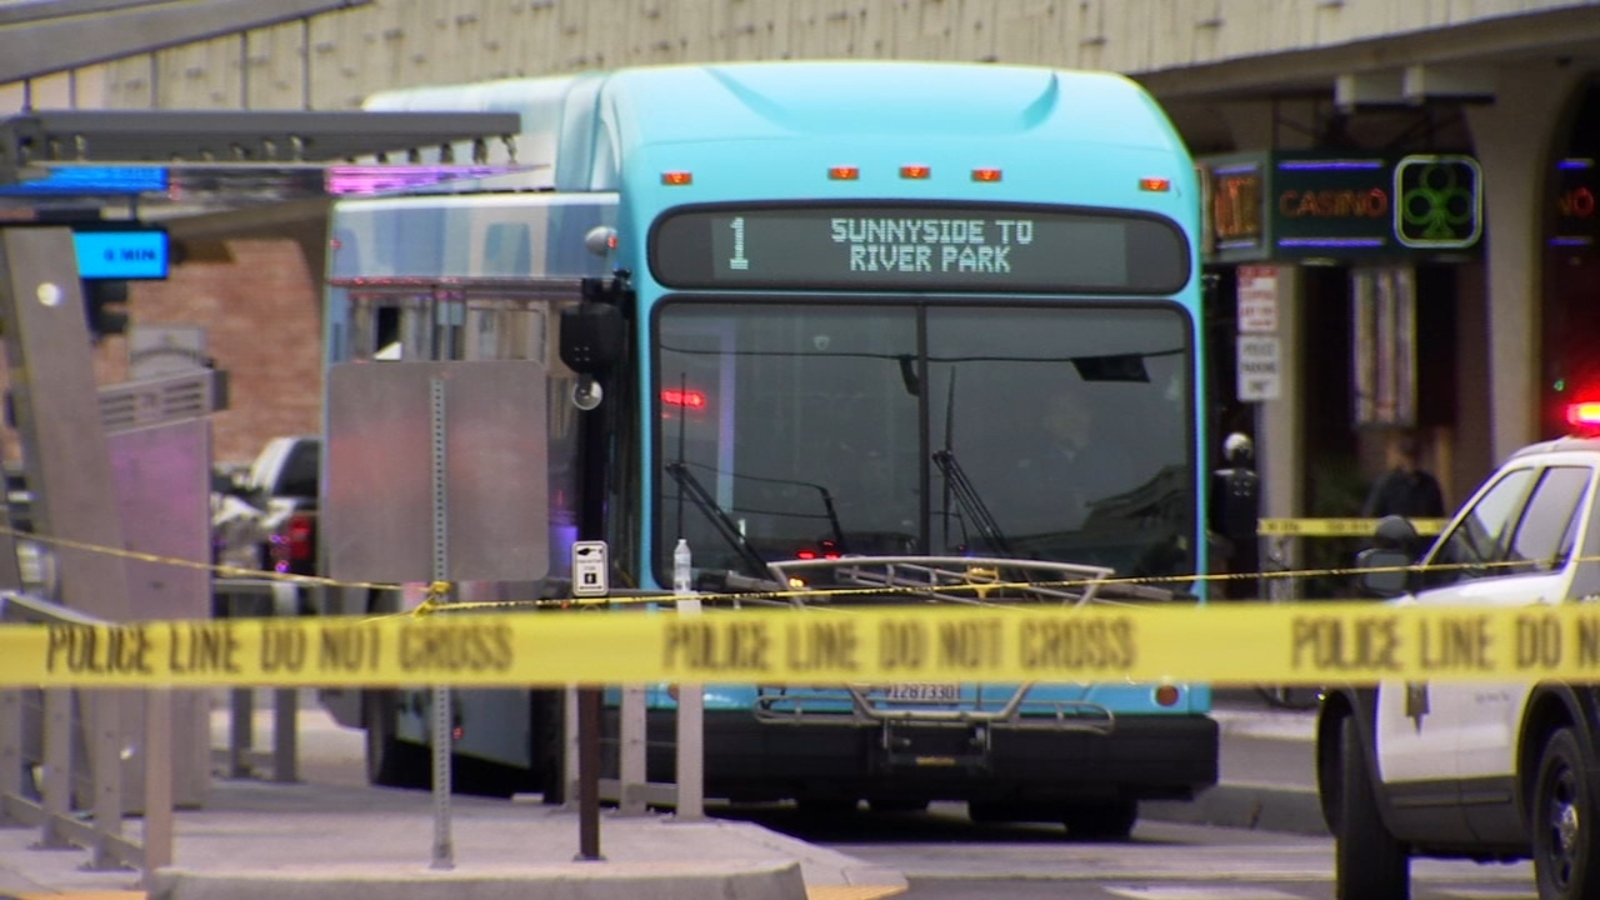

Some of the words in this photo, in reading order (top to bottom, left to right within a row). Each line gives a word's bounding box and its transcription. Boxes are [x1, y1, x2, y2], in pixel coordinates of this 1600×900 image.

[1279, 188, 1388, 218] CASINO
[729, 217, 749, 270] 1
[831, 218, 985, 244] SUNNYSIDE
[995, 219, 1034, 245] TO
[850, 244, 932, 272] RIVER
[941, 244, 1011, 273] PARK
[46, 624, 153, 674] POLICE
[168, 622, 240, 674] LINE
[260, 622, 306, 674] DO
[318, 622, 381, 673] NOT
[399, 622, 514, 673] CROSS
[662, 620, 769, 671] POLICE
[786, 620, 858, 671] LINE
[878, 620, 926, 671] DO
[937, 620, 1004, 671] NOT
[1018, 616, 1137, 671] CROSS
[1290, 615, 1402, 672] POLICE
[1419, 615, 1496, 670] LINE
[1514, 615, 1563, 670] DO
